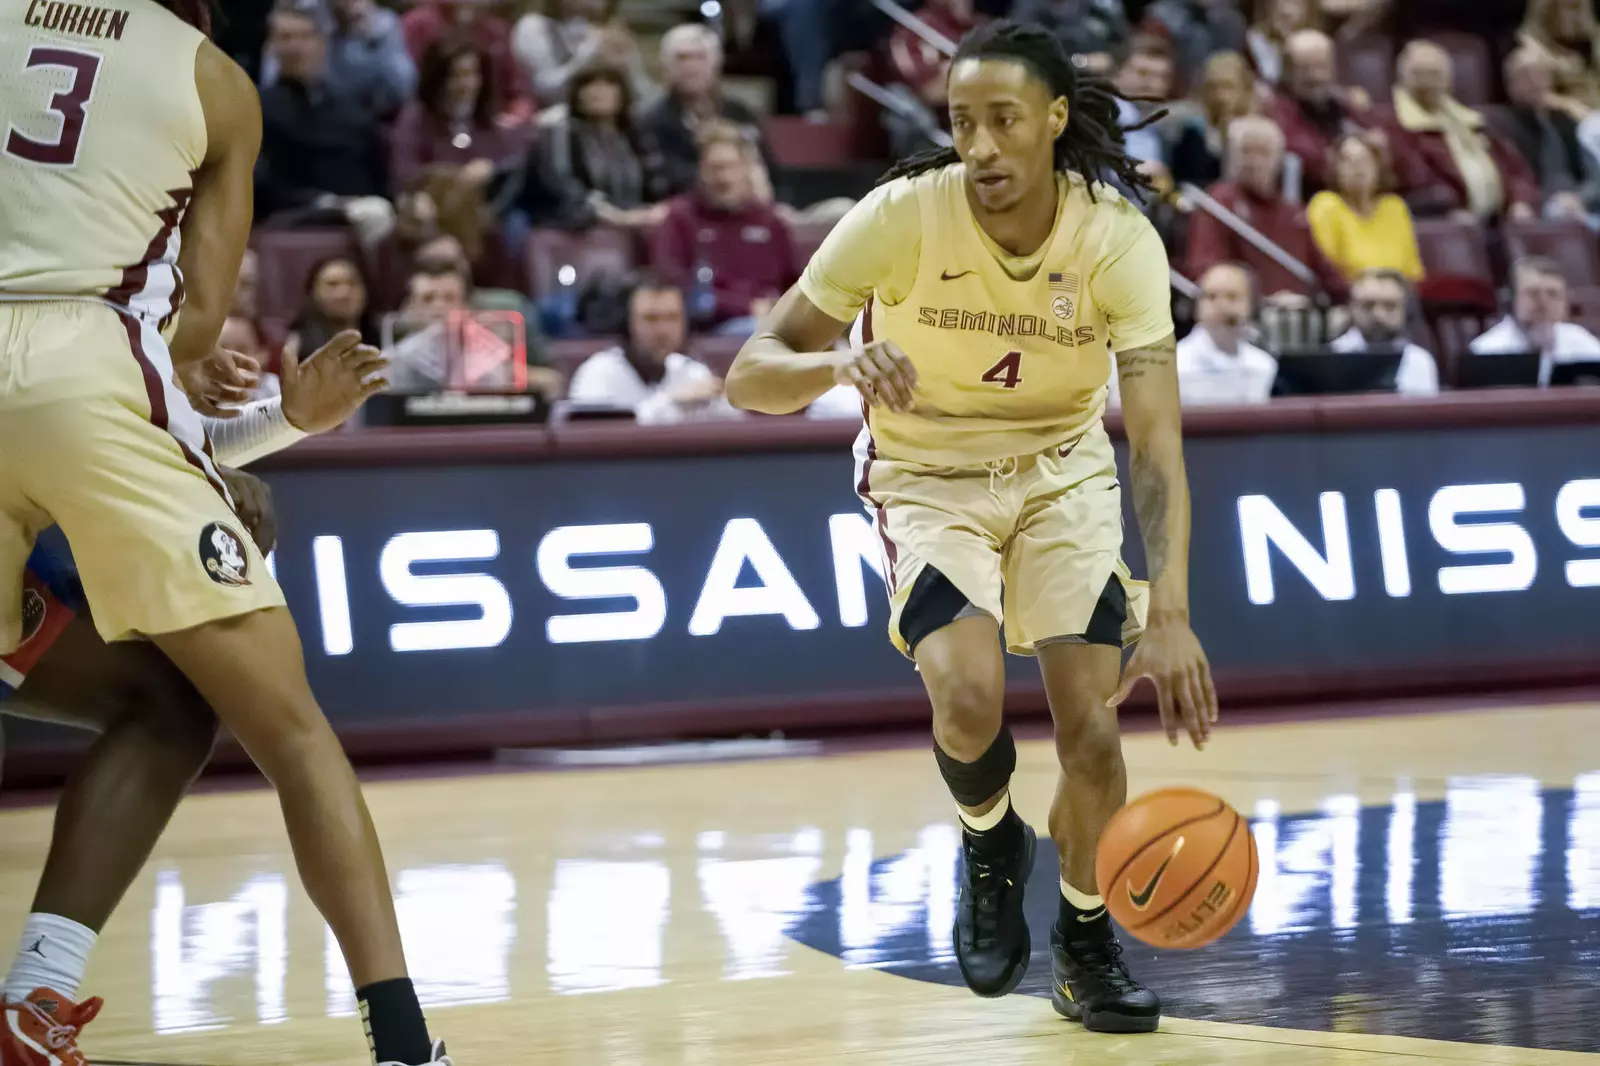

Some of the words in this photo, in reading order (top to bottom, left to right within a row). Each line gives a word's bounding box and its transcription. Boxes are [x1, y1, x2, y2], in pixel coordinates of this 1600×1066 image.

[24, 0, 130, 41] CORHEN
[4, 45, 104, 168] 3
[918, 306, 1096, 347] SEMINOLES
[981, 350, 1023, 390] 4
[263, 513, 886, 656] ISSA
